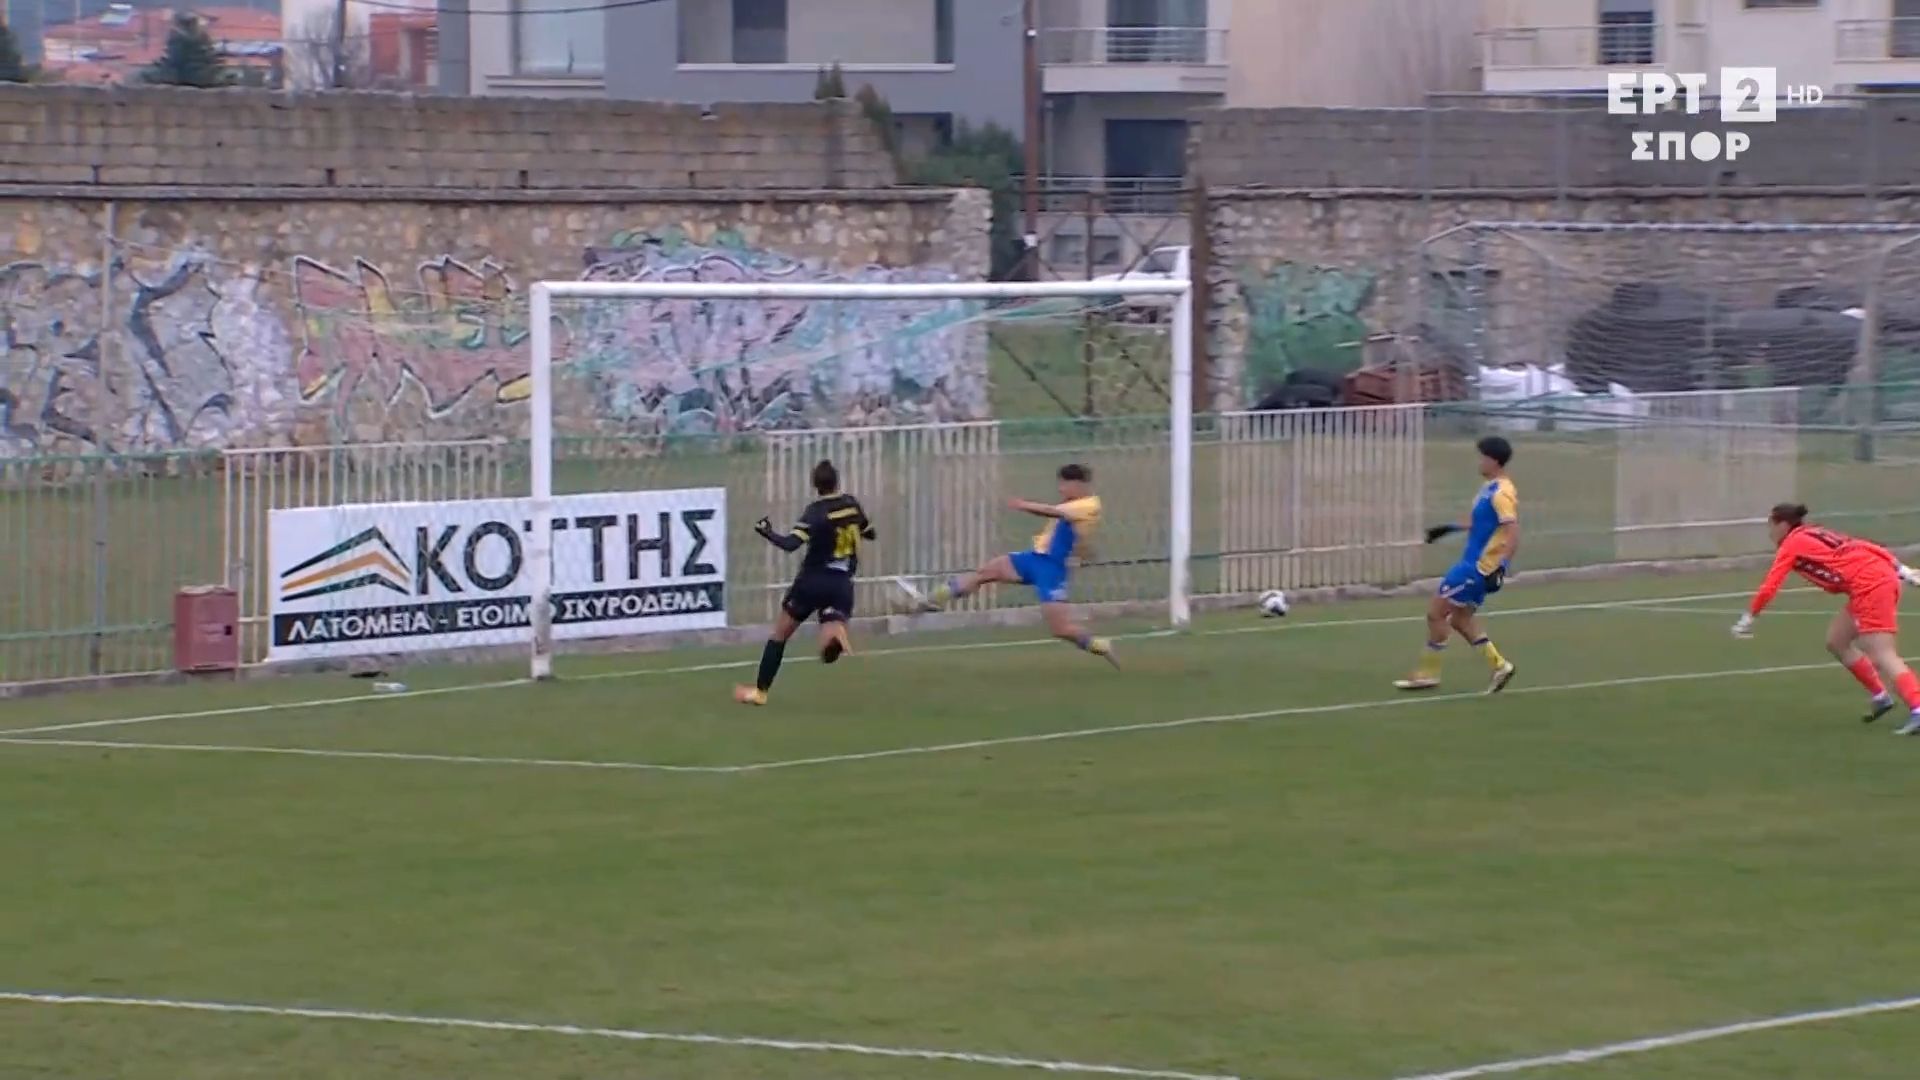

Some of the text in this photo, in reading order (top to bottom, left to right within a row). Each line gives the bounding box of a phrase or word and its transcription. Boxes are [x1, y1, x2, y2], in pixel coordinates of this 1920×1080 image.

[288, 611, 431, 641] ΛΑΤΟΜΕΙΑ
[457, 603, 557, 627] ΕΤΟΙΜ
[562, 591, 713, 620] ΣΚΥΡΟΔΕΜΑ
